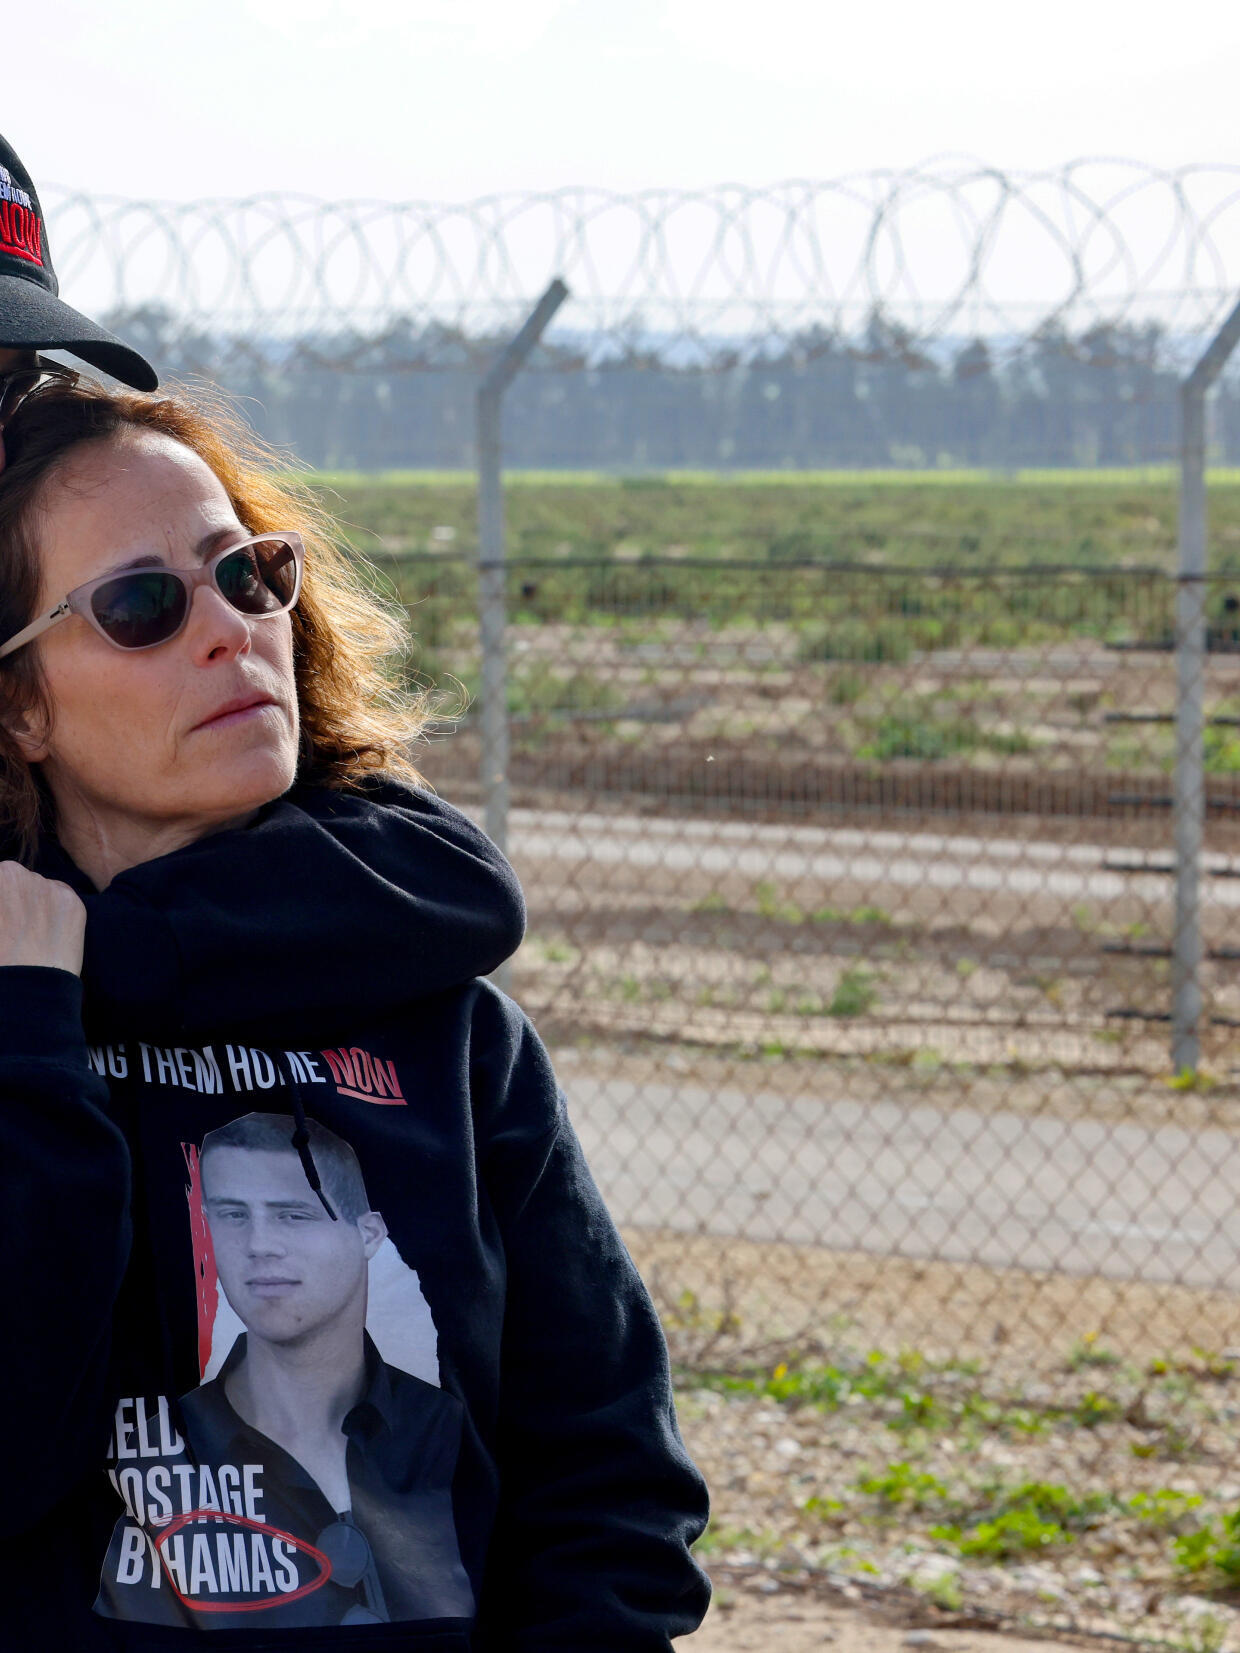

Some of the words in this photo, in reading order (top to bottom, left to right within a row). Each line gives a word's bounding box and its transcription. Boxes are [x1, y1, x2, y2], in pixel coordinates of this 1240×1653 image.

[87, 1044, 129, 1078] NG
[139, 1042, 224, 1095] THEM
[321, 1047, 403, 1098] NOW
[107, 1395, 186, 1459] ELD
[160, 1532, 299, 1595] HAMAS
